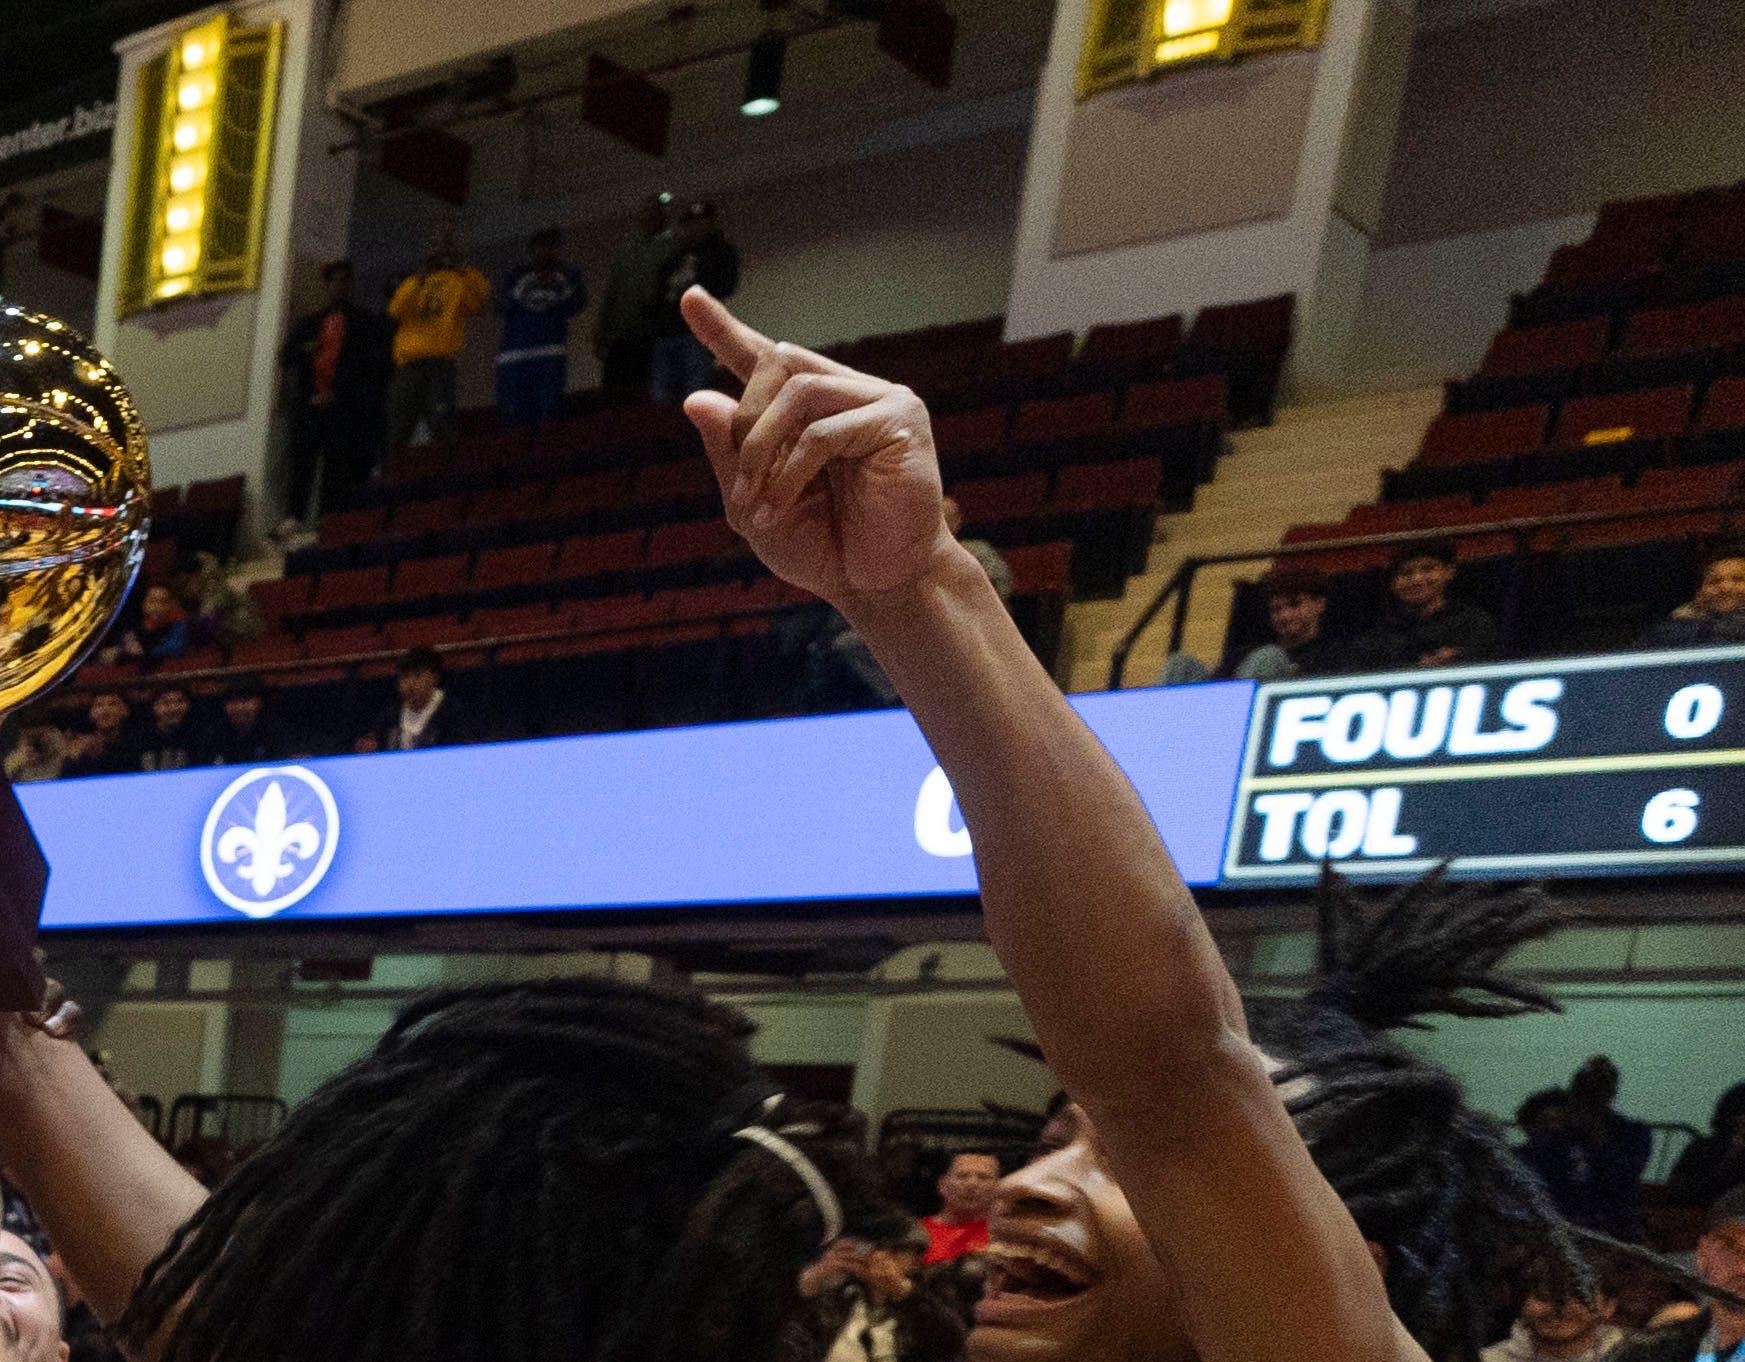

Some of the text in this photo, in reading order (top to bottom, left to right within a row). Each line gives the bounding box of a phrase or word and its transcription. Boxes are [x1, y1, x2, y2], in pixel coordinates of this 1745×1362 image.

[1268, 678, 1724, 767] FOULS 0
[1254, 788, 1699, 860] TOL 6
